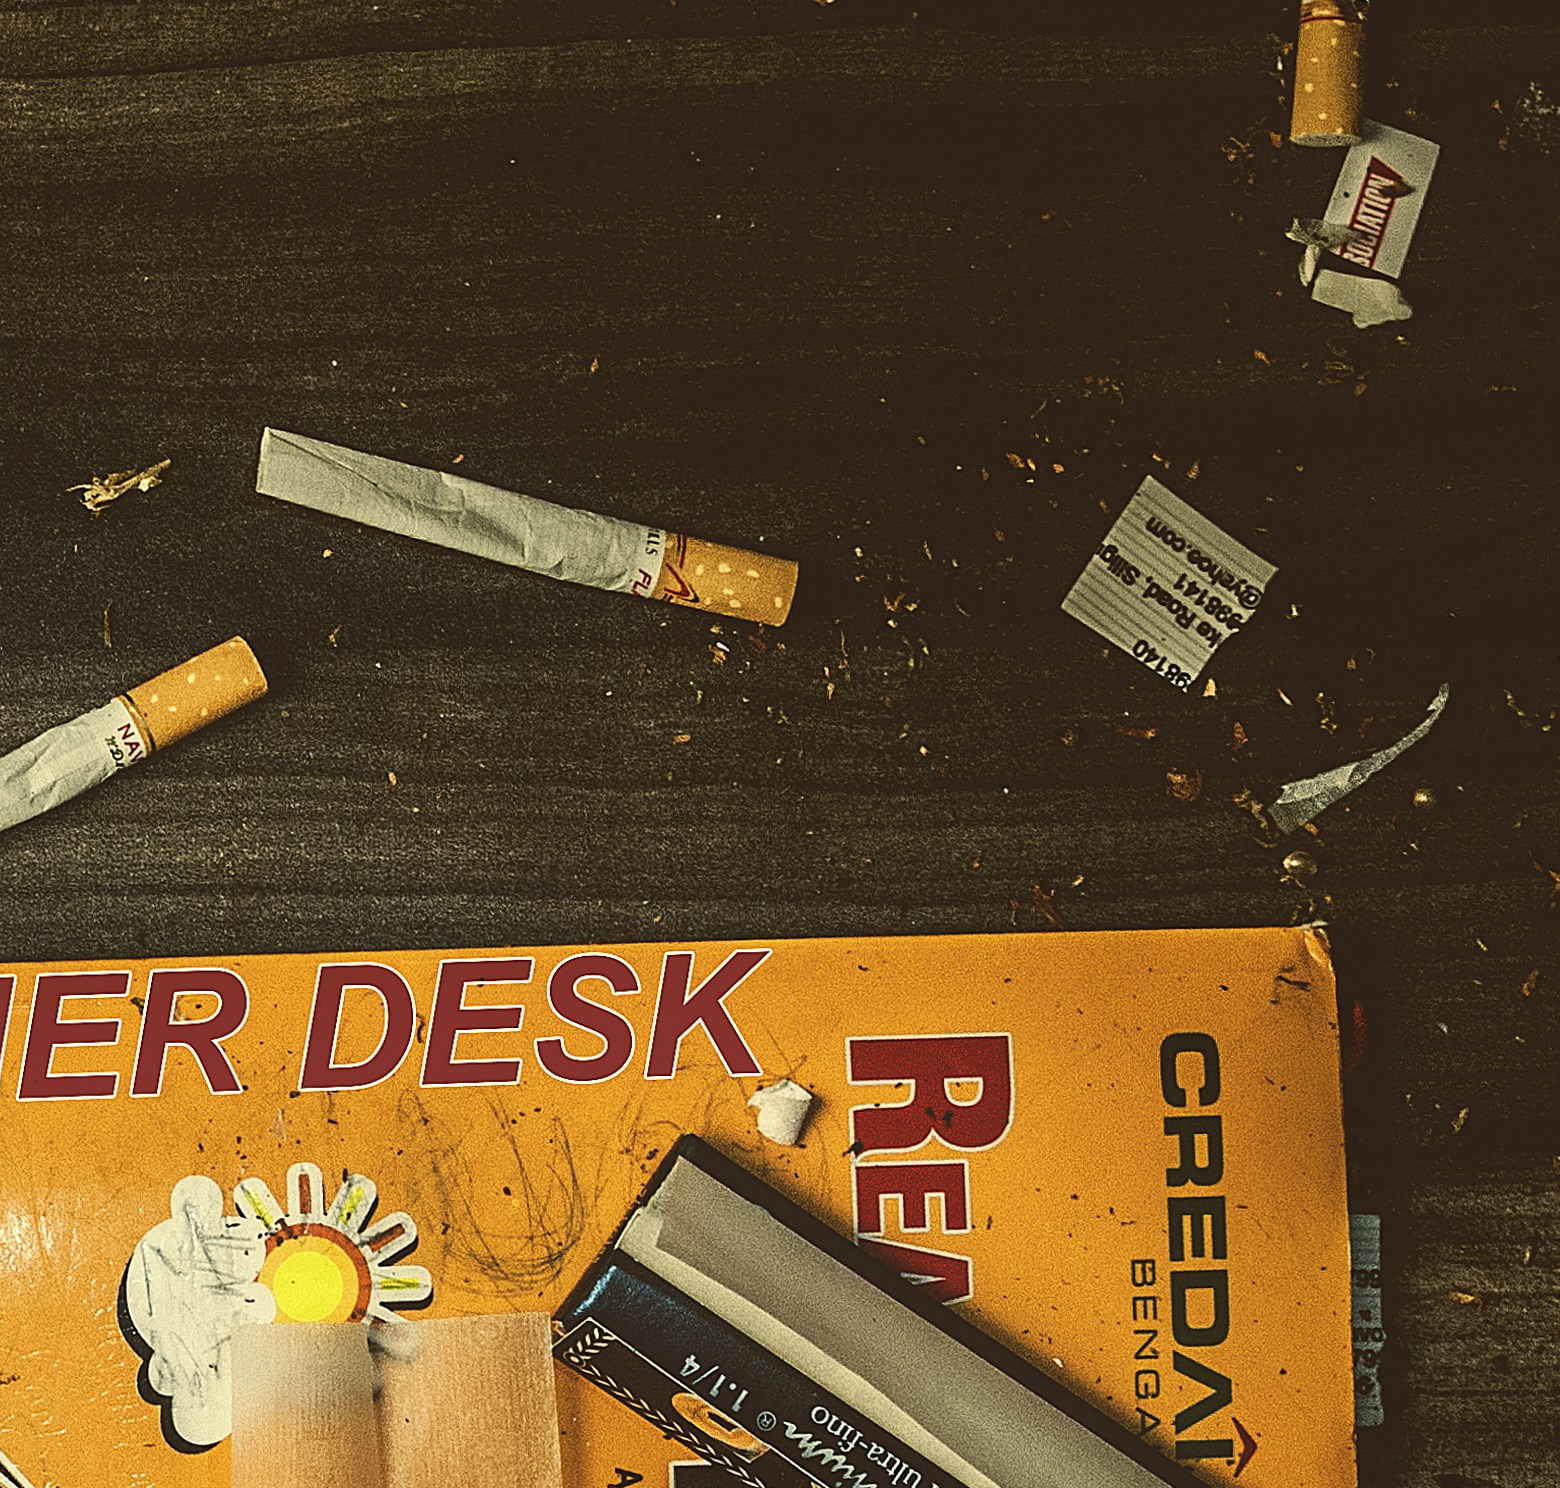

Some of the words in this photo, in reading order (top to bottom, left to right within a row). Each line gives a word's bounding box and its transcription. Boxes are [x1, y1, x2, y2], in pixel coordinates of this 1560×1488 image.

[846, 1032, 1014, 1303] REA
[679, 1354, 749, 1413] 1.1/4
[1130, 1258, 1161, 1440] BENGA
